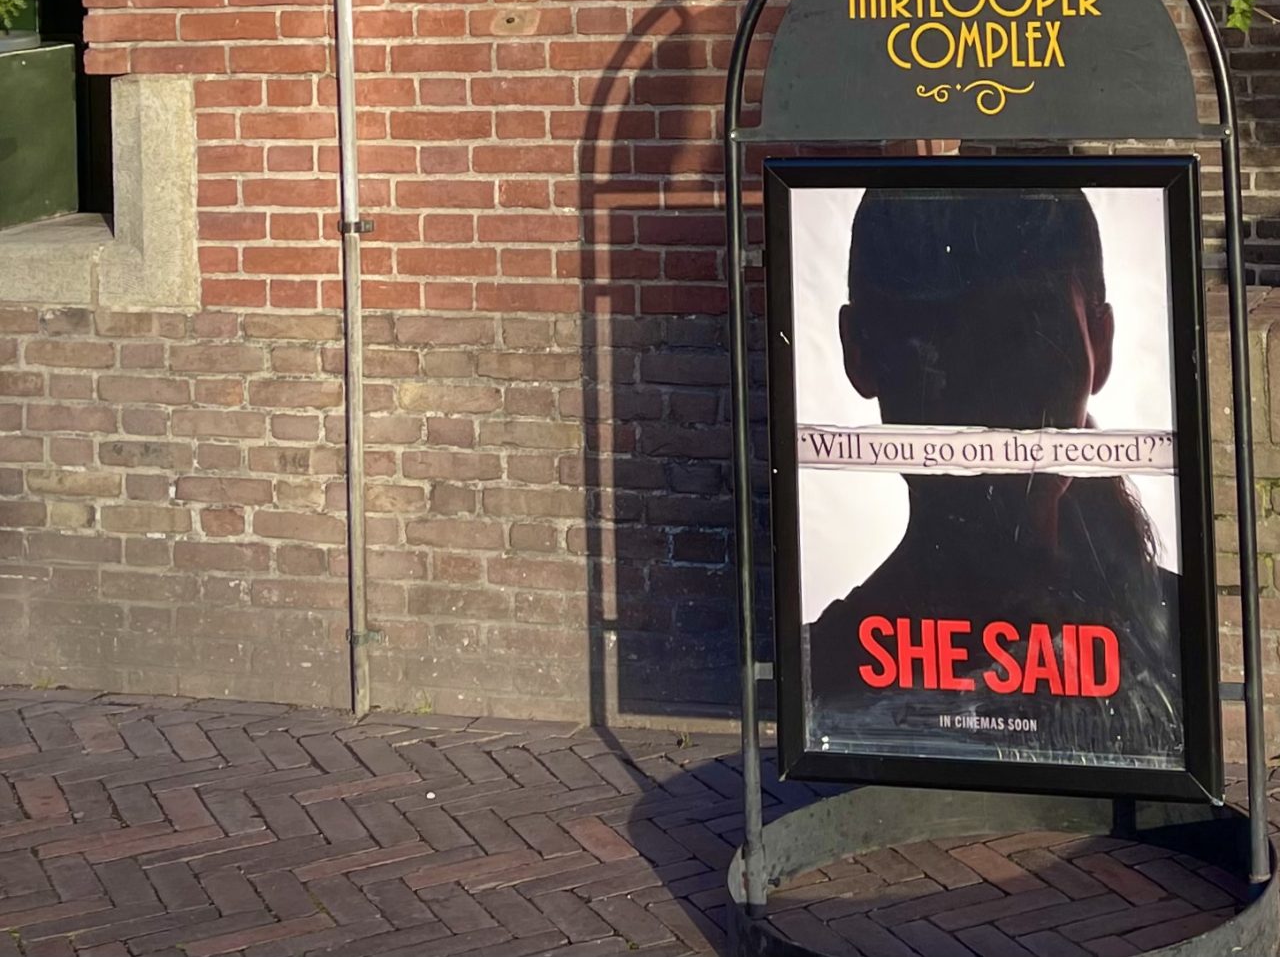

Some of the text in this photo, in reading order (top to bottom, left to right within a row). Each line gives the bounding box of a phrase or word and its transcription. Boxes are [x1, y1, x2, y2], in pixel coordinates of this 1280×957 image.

[886, 20, 1066, 69] COMPLEX
[868, 438, 914, 465] you
[923, 441, 955, 467] go
[961, 440, 994, 462] on
[1003, 436, 1044, 463] the
[858, 615, 1121, 698] SHE SAID
[939, 714, 1038, 732] IN CINEMAS SOON
